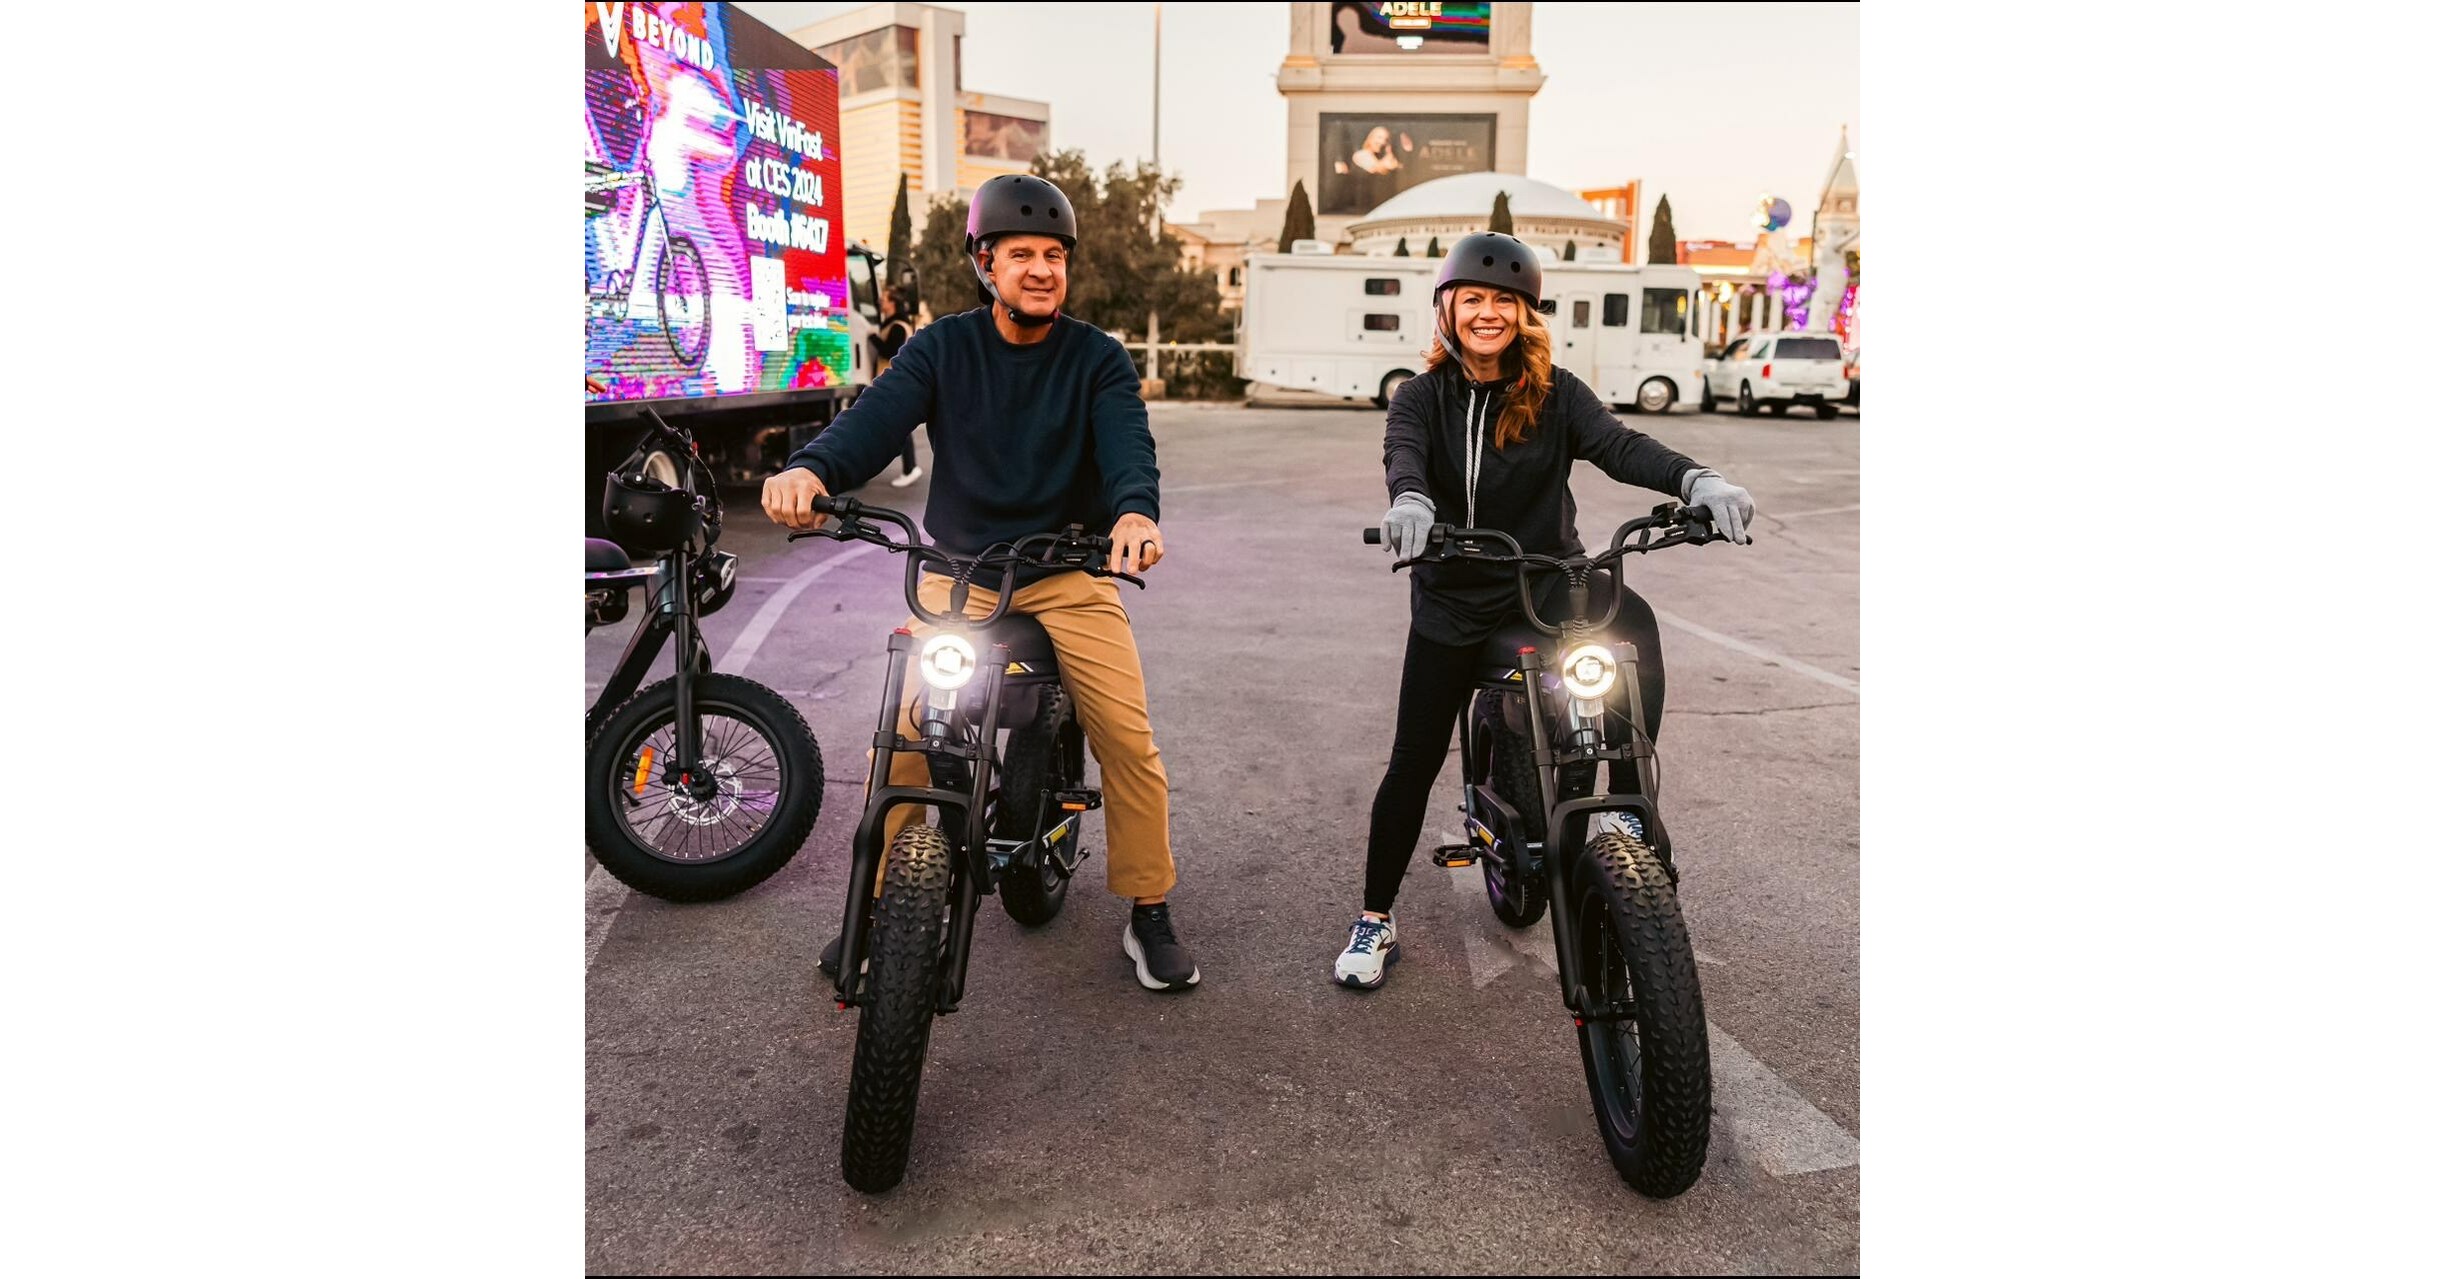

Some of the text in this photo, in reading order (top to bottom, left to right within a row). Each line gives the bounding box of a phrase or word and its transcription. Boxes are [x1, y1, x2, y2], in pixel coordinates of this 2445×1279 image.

[1380, 2, 1442, 16] ADELE
[632, 6, 714, 71] BEYOND
[743, 97, 823, 161] Visit VinFast
[746, 157, 823, 207] at CES 2024
[746, 202, 790, 246] Booth
